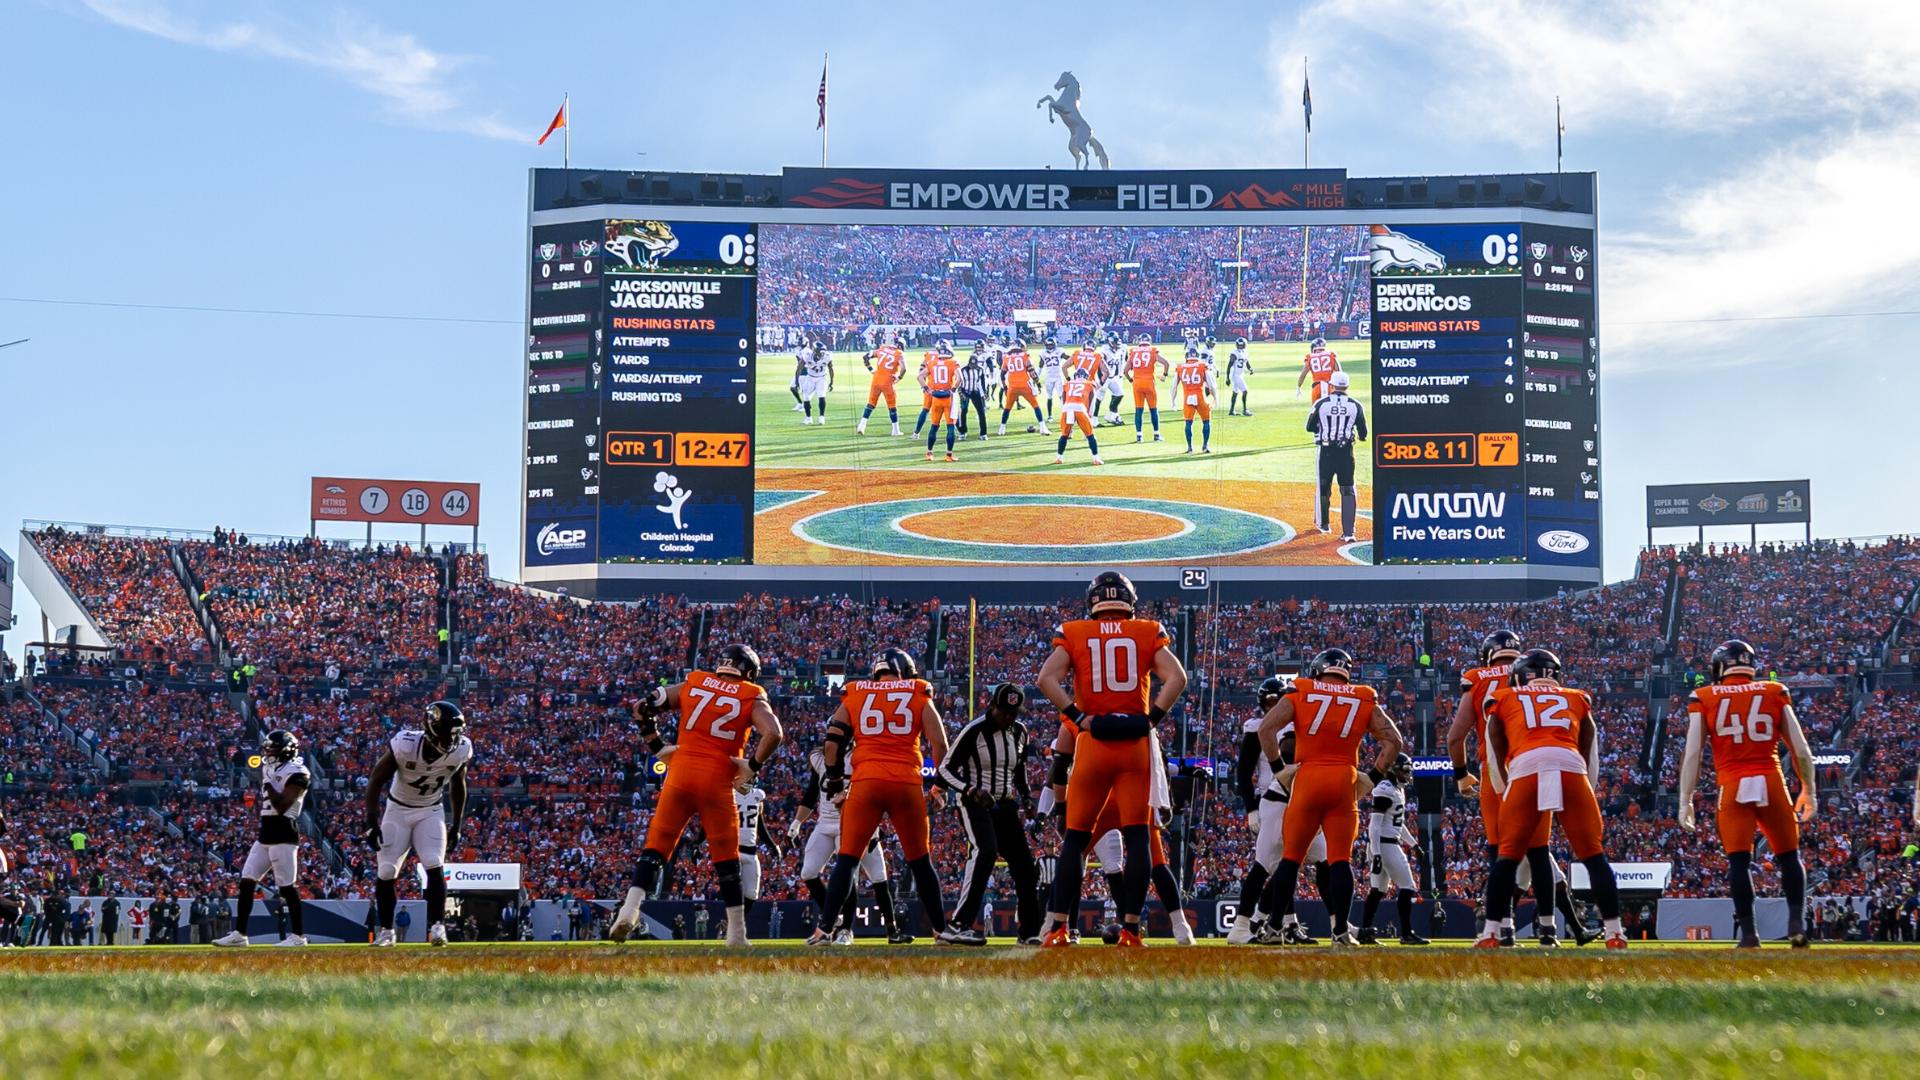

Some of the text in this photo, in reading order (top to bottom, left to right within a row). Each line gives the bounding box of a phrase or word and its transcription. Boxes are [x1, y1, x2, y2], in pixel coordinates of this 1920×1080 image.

[1291, 184, 1303, 192] AT
[1306, 183, 1343, 196] MILE
[890, 183, 1213, 210] EMPOWER FIELD
[1306, 196, 1345, 208] HIGH
[719, 234, 743, 265] 0
[1482, 234, 1506, 265] 0
[541, 263, 550, 279] 0
[583, 260, 592, 274] 0
[1533, 262, 1542, 277] 0
[1575, 266, 1584, 281] 0
[610, 280, 721, 295] JACKSONVILLE
[1377, 283, 1435, 296] DENVER
[610, 293, 704, 309] JAGUARS
[1377, 296, 1471, 311] BRONCOS
[533, 313, 586, 326] RECEIVING LEADER
[613, 317, 715, 330] RUSHING STATS
[1380, 320, 1480, 332] RUSHING STATS
[1526, 314, 1579, 328] RECEIVING LEADER
[612, 336, 747, 349] ATTEMPTS 0
[1380, 338, 1513, 350] ATTEMPTS 1
[541, 350, 554, 360] YDS
[554, 350, 564, 359] TD
[612, 355, 747, 368] YARDS 0
[878, 352, 895, 370] 72
[1045, 356, 1059, 367] 23
[1133, 351, 1151, 368] 69
[1380, 356, 1513, 367] YARDS 4
[1536, 350, 1549, 359] YDS
[1550, 351, 1559, 360] TD
[1008, 356, 1025, 373] 60
[1310, 355, 1332, 373] 82
[612, 373, 702, 385] YARDS/ATTEMPT
[932, 365, 949, 384] 10
[1181, 367, 1201, 385] 46
[1380, 375, 1513, 387] YARDS/ATTEMPT 4
[552, 383, 560, 392] TD
[1068, 383, 1085, 397] 12
[1548, 384, 1557, 393] TD
[612, 392, 747, 404] RUSHING TDS 0
[1381, 393, 1514, 404] RUSHING TDS 0
[1330, 406, 1347, 416] 83
[551, 418, 574, 429] LEADER
[1550, 420, 1572, 430] LEADER
[610, 441, 646, 457] QTR
[653, 439, 663, 459] 1
[681, 440, 747, 459] 12:47
[1383, 441, 1467, 460] 3RD & 11
[1491, 443, 1506, 463] 7
[322, 498, 346, 506] RETIRED
[370, 492, 379, 508] 7
[406, 494, 425, 510] 18
[446, 495, 466, 511] 44
[1391, 491, 1506, 519] ARROW
[1777, 495, 1802, 513] 50
[320, 507, 347, 515] NUMBERS
[544, 529, 587, 545] ACP
[640, 532, 713, 543] Children's Hospital
[1393, 525, 1506, 540] Five Years Out
[659, 544, 695, 552] Colorado
[1549, 533, 1578, 549] Ford
[1184, 570, 1205, 586] 24
[1105, 587, 1117, 599] 10
[1100, 622, 1122, 634] NIX
[722, 658, 733, 667] 72
[1087, 637, 1138, 693] 10
[1335, 659, 1346, 668] 77
[1542, 668, 1554, 679] 12
[702, 677, 740, 694] BOLLES
[855, 680, 916, 691] PALCZEWSKI
[1313, 680, 1356, 695] MEINERZ
[1711, 681, 1767, 696] PRENTICE
[685, 687, 742, 741] 72
[859, 691, 915, 736] 63
[1306, 693, 1361, 739] 77
[1517, 693, 1571, 730] 12
[1715, 694, 1774, 744] 46
[407, 775, 446, 796] 41
[455, 870, 502, 881] Chevron
[1615, 871, 1653, 880] hevron
